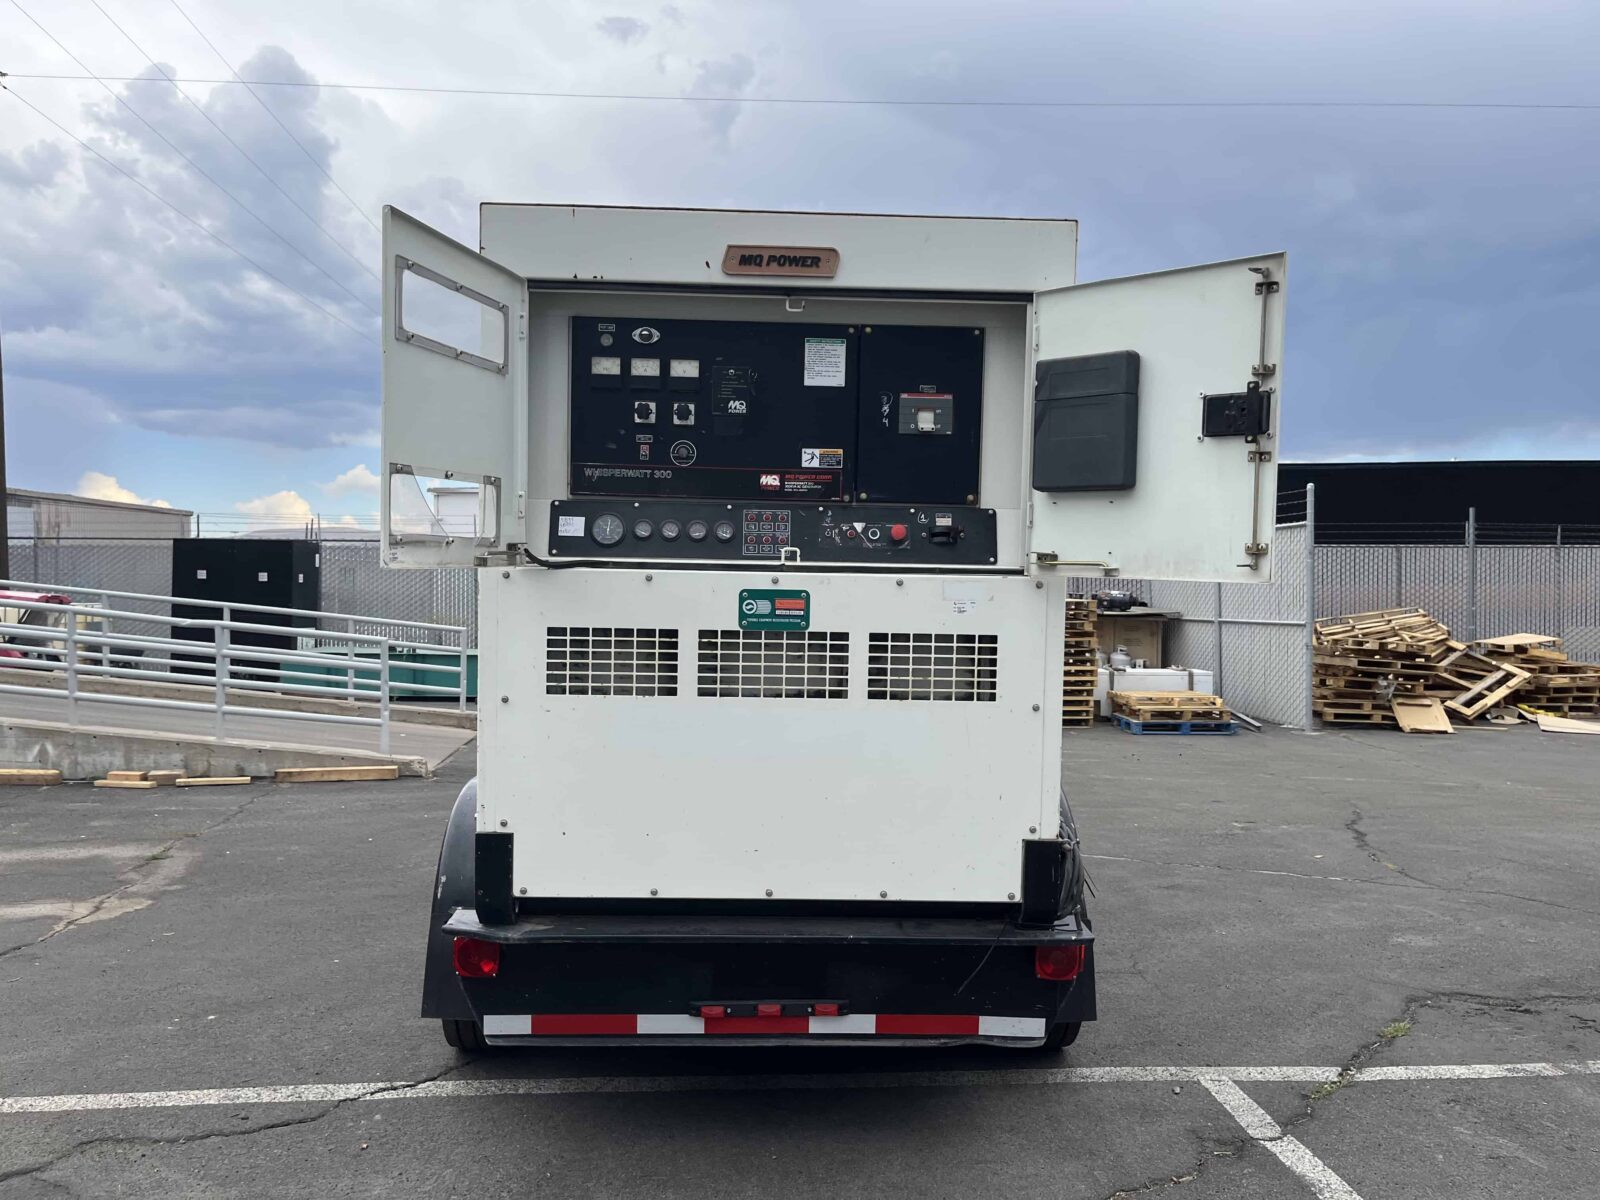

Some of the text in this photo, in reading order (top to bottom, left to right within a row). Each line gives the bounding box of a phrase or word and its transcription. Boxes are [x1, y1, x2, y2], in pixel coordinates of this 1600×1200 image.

[738, 254, 821, 269] MQ POWER
[728, 400, 746, 410] MQ
[584, 467, 673, 479] WHISPERWATT 300
[760, 475, 780, 486] MQ
